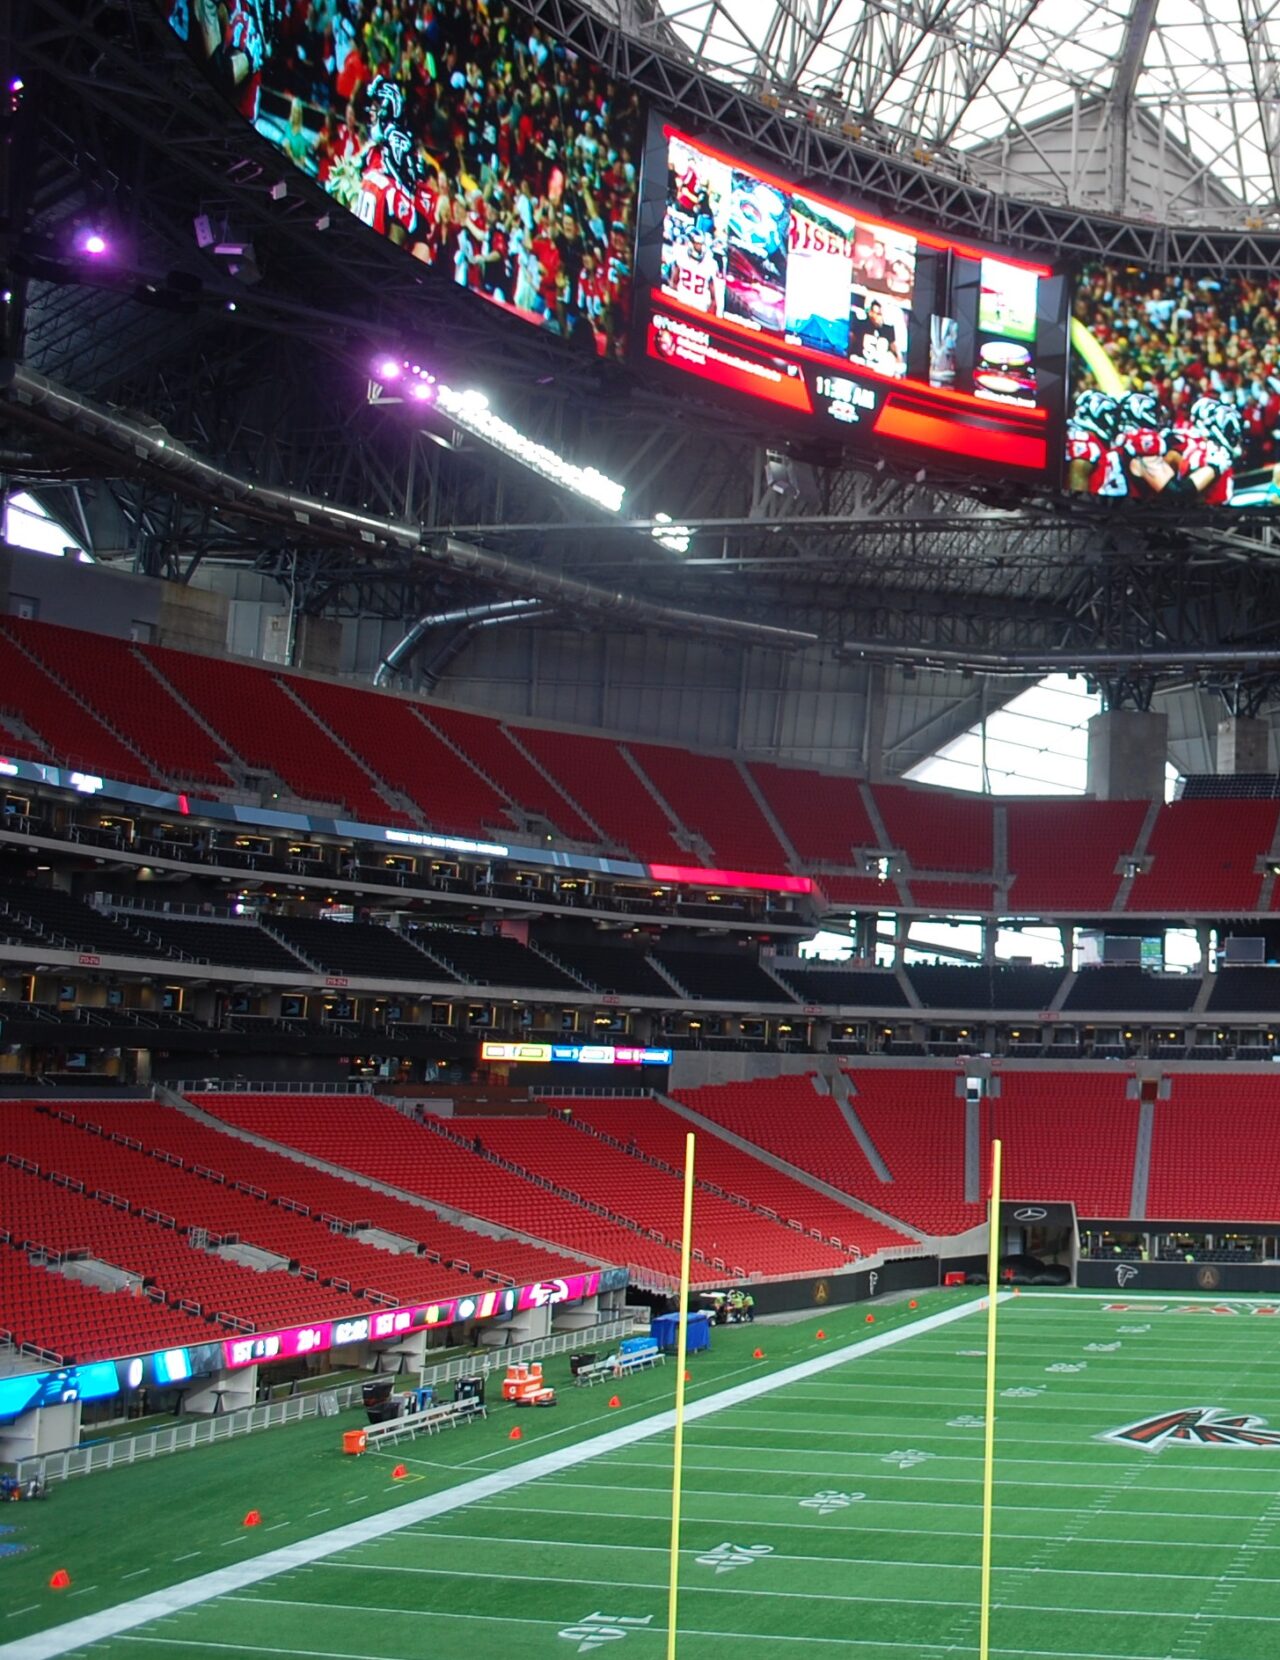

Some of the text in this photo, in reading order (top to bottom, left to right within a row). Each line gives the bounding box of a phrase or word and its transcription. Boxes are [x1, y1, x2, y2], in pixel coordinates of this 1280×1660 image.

[681, 269, 706, 295] 22
[129, 1358, 143, 1387] 0
[558, 1611, 654, 1641] 10
